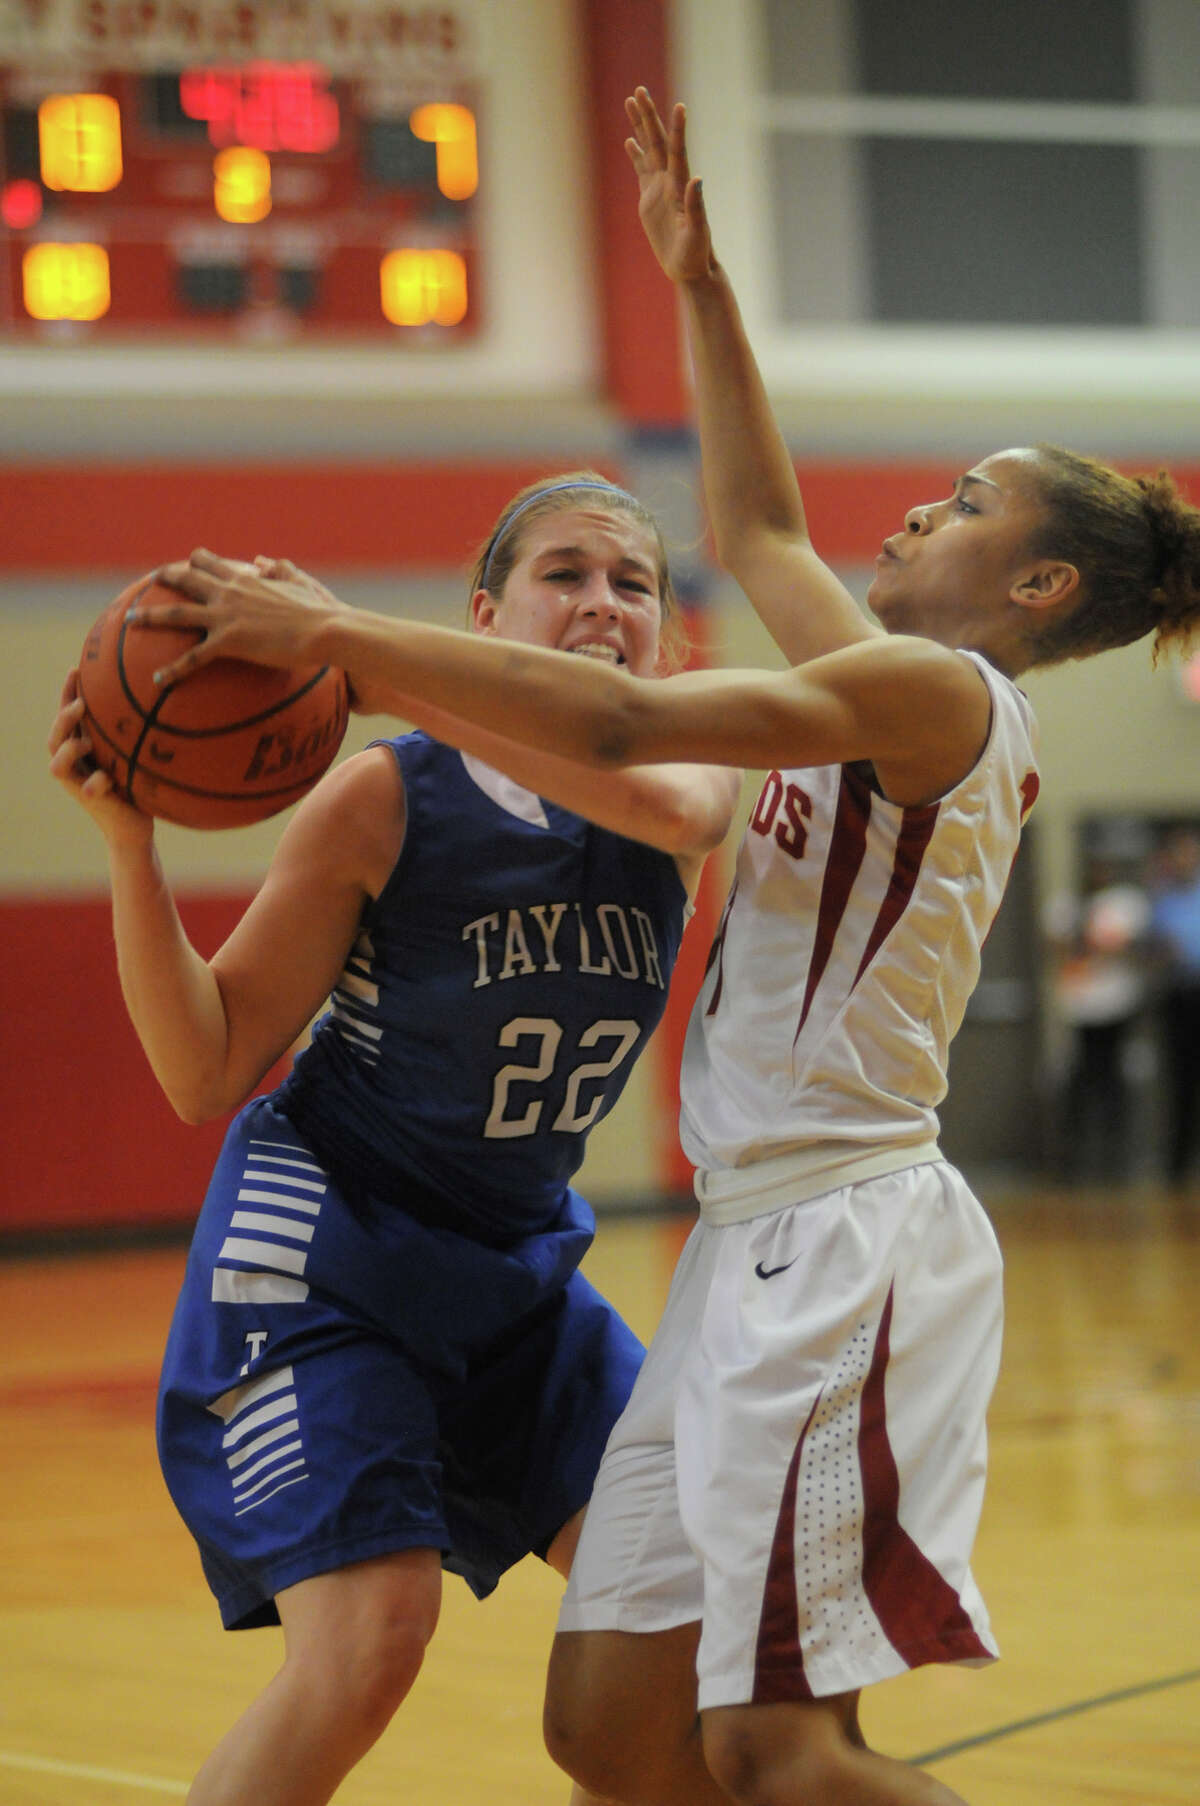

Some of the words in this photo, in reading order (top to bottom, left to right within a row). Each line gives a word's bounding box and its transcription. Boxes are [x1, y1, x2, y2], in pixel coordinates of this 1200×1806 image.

[747, 768, 812, 860] DS
[461, 902, 665, 991] TAYLOR
[483, 1016, 642, 1139] 22
